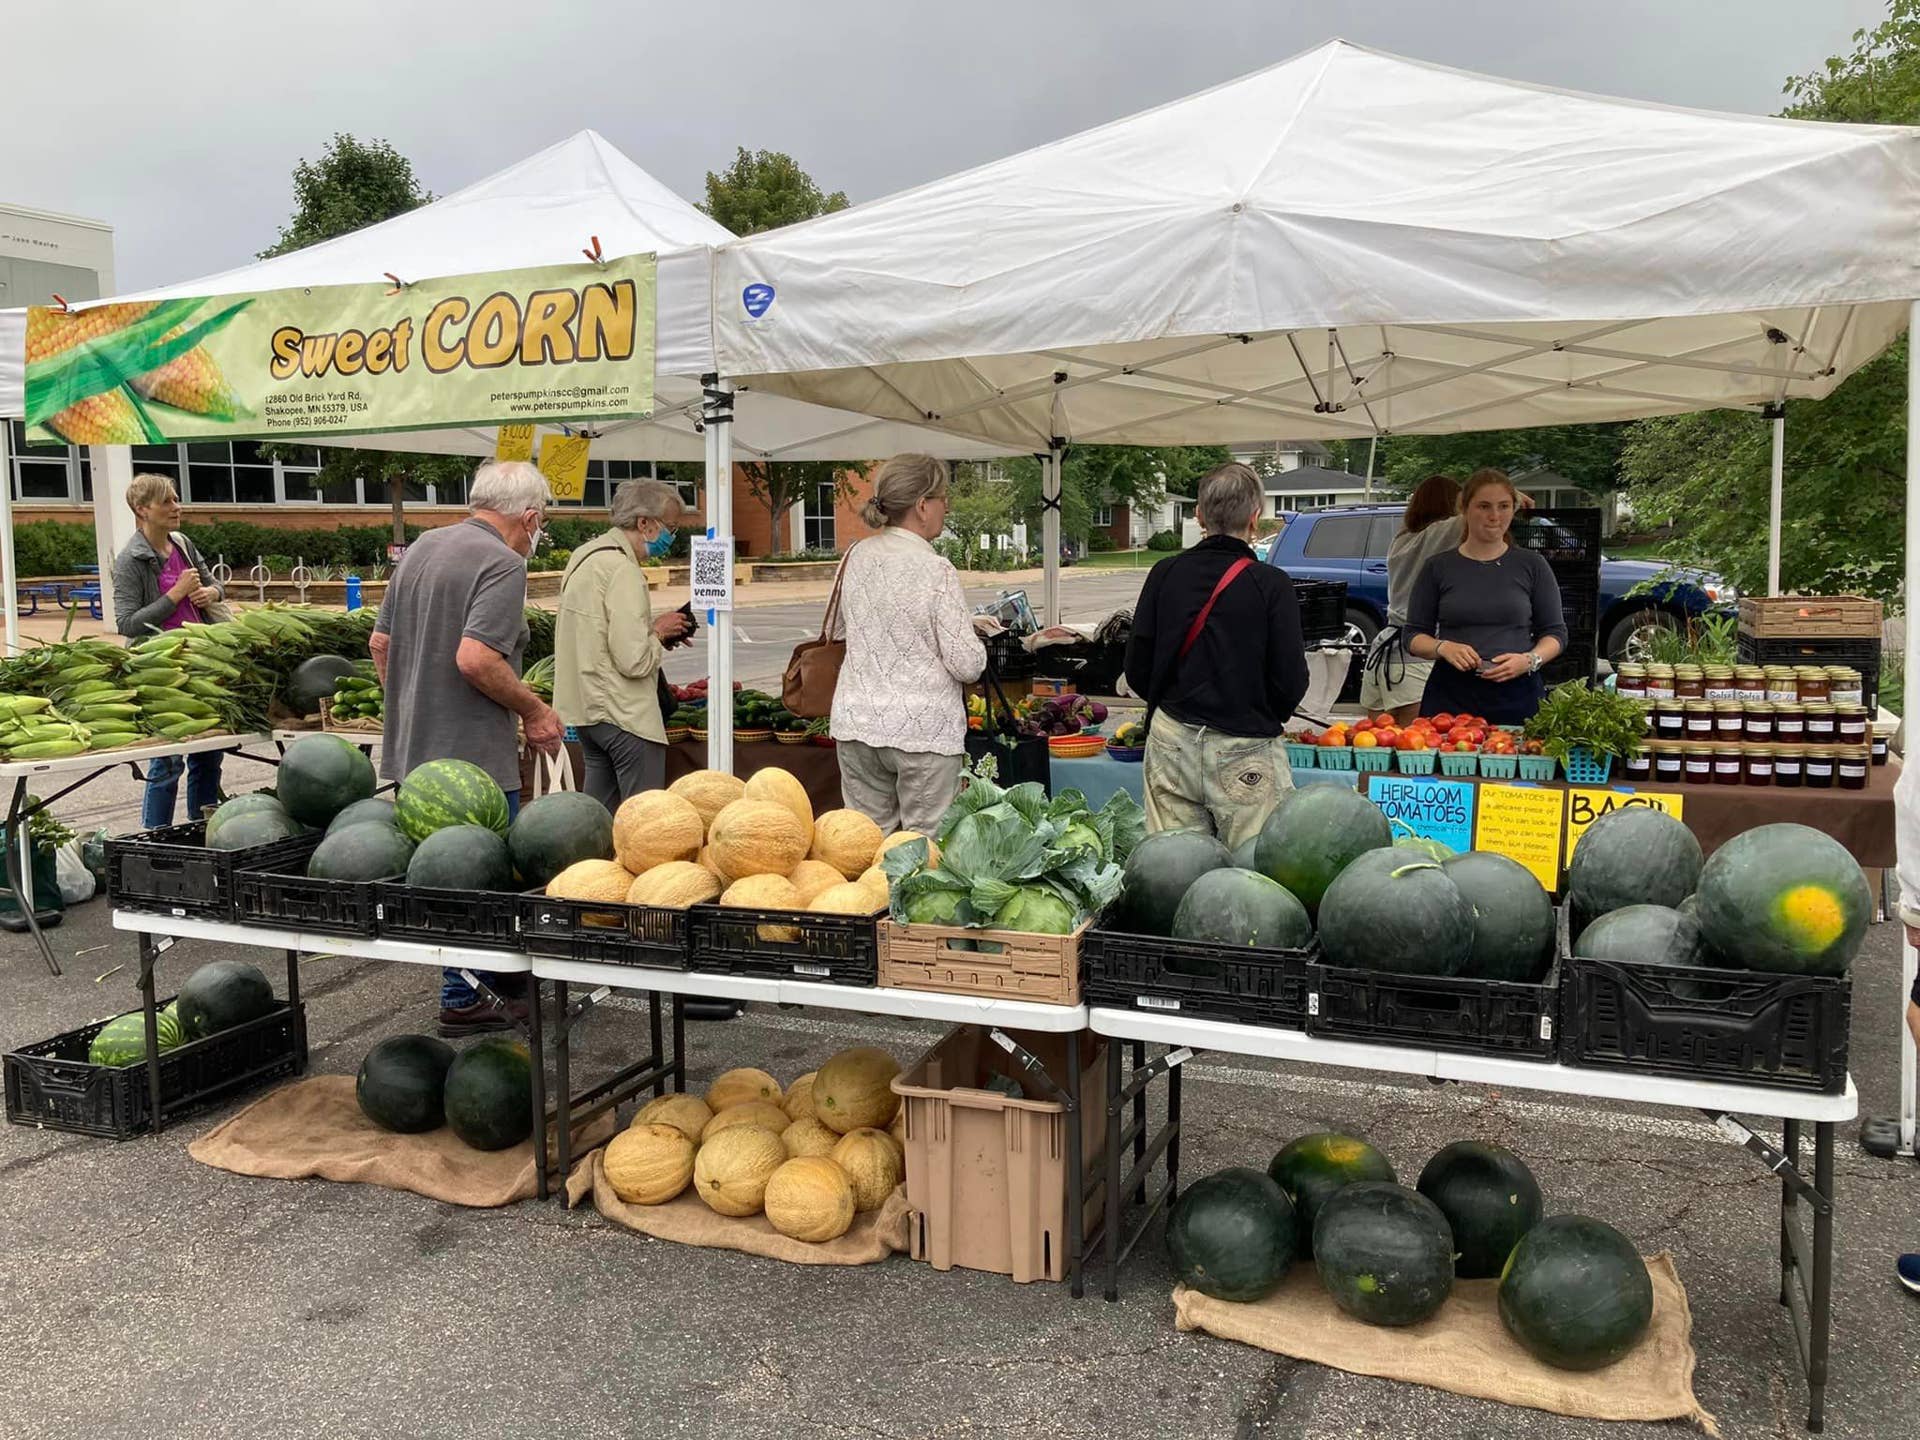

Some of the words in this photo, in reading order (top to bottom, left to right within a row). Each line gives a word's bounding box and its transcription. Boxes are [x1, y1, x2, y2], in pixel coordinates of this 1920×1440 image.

[270, 317, 413, 380] Sweet
[421, 279, 637, 374] CORN
[265, 394, 287, 404] 12860
[289, 393, 303, 403] Old
[305, 392, 325, 402] Brick
[327, 391, 345, 401] Yard
[490, 385, 629, 403] peterspumpkinscc@gmail.com
[265, 406, 305, 416] Shakopee,
[308, 405, 321, 413] MN
[350, 402, 368, 412] USA
[510, 397, 628, 413] www.peterspumpkins.com
[267, 418, 291, 427] Phone
[293, 416, 312, 427] (952)
[694, 588, 726, 598] venmo
[1381, 783, 1462, 805] HEIRLOOM
[1500, 791, 1545, 801] TOMATOES
[1375, 801, 1466, 824] TOMATOES
